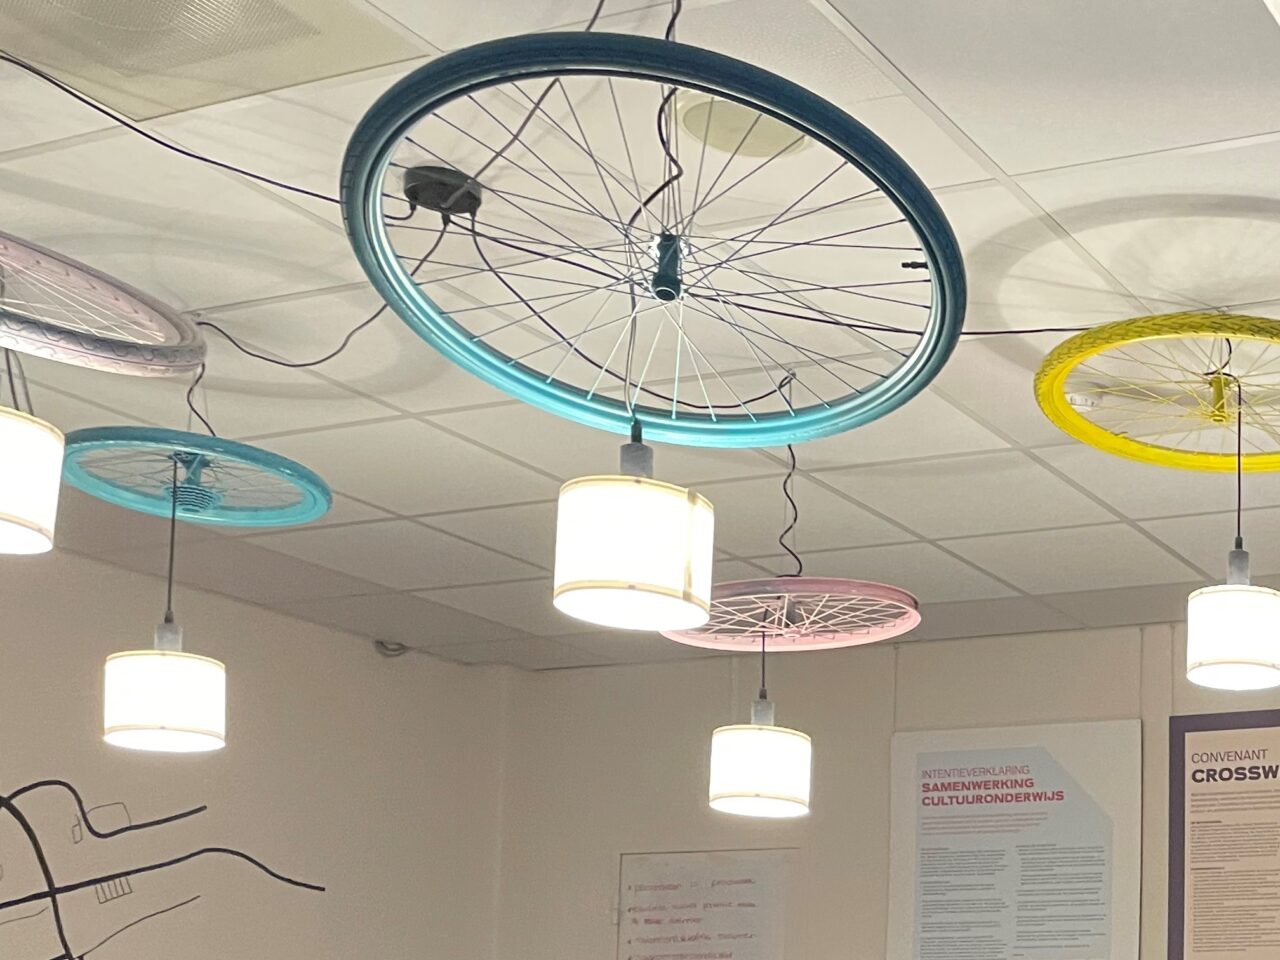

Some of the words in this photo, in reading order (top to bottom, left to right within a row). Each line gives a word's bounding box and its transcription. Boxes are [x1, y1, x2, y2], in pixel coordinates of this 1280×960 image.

[1191, 748, 1268, 764] CONVENANT
[921, 765, 1031, 779] INTENTIEVERKLARING
[921, 778, 1035, 793] SAMENWERKING
[921, 791, 1065, 806] CULTUURONDERWIJS
